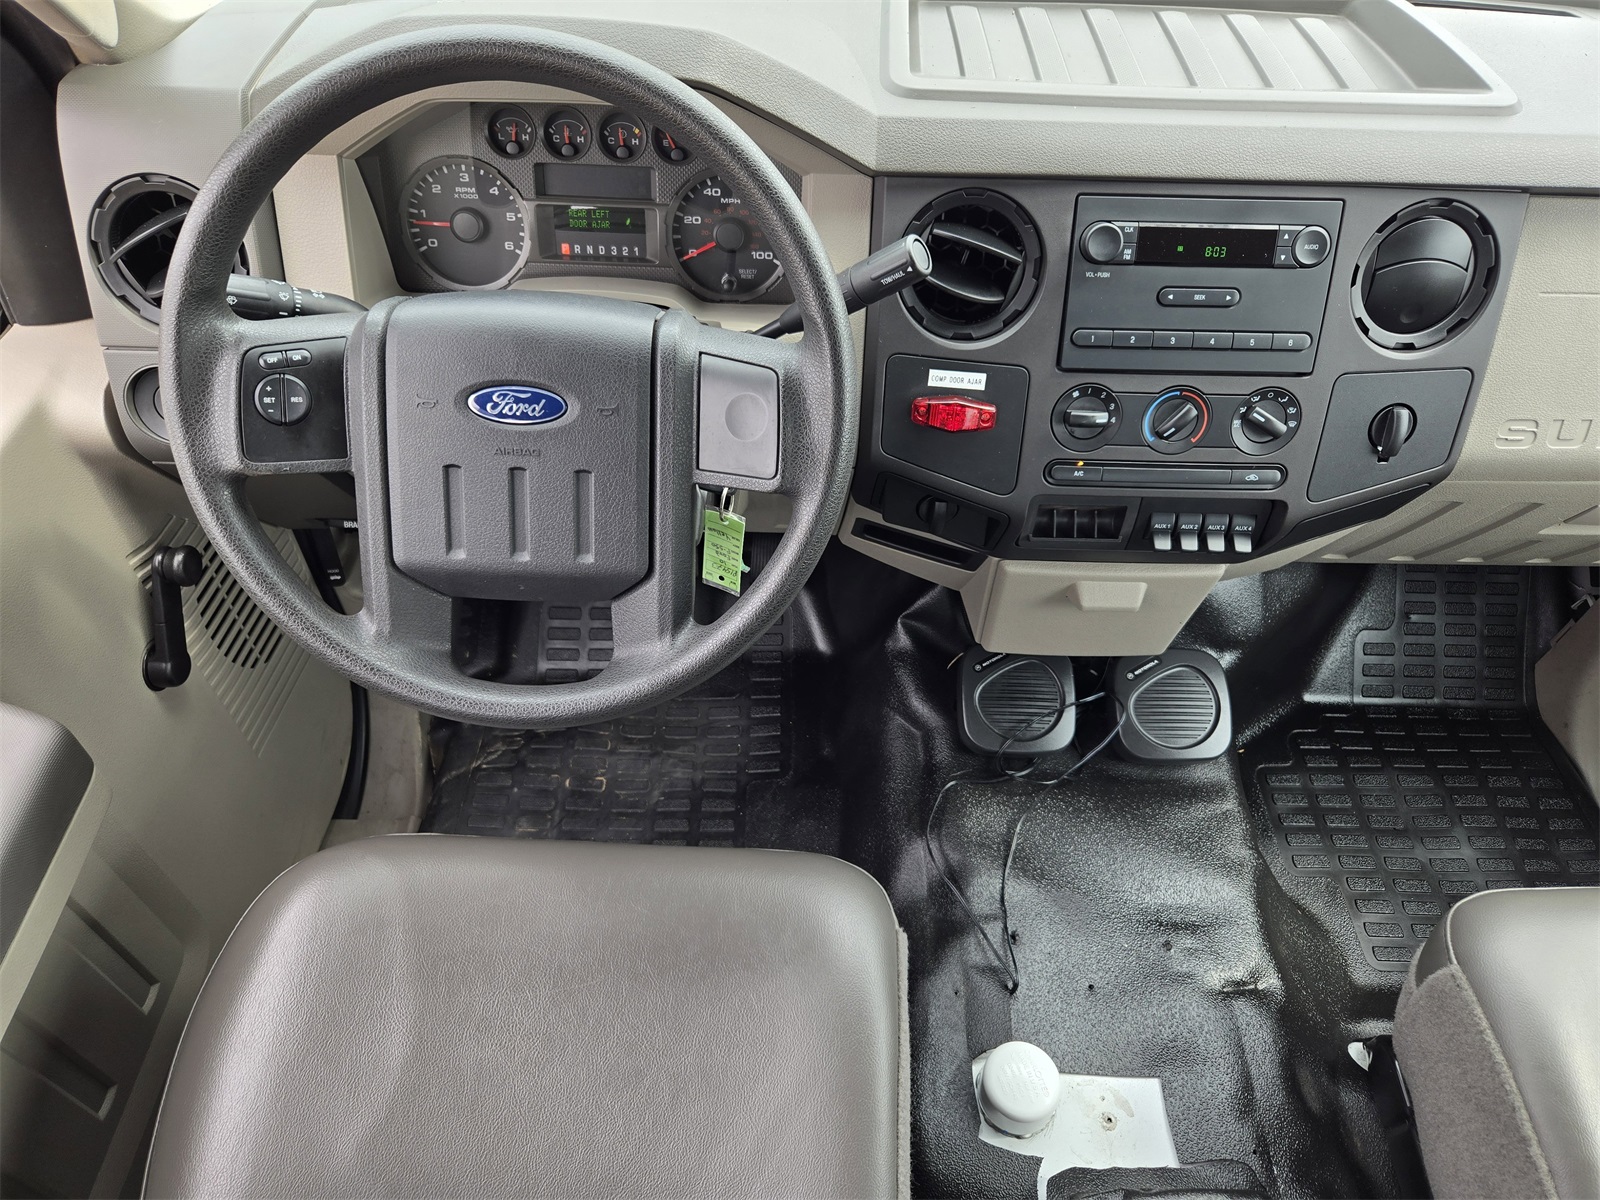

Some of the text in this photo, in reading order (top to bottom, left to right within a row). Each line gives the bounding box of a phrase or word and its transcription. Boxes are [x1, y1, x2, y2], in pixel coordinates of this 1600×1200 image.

[522, 133, 530, 142] H
[552, 134, 560, 143] C
[577, 135, 585, 144] H
[607, 136, 615, 145] C
[631, 138, 639, 146] H
[662, 139, 670, 147] E
[459, 172, 470, 182] 3
[432, 184, 442, 194] 2
[489, 186, 500, 196] 4
[703, 188, 722, 197] 40
[420, 209, 427, 218] 1
[506, 212, 516, 222] 5
[568, 208, 610, 218] REAR LEFT
[569, 220, 611, 229] DOOR AJAR
[684, 216, 702, 225] 20
[428, 238, 438, 248] 0
[504, 241, 514, 250] 6
[574, 244, 581, 254] R
[586, 246, 594, 255] N
[599, 246, 606, 255] D
[611, 246, 618, 256] 3
[622, 246, 629, 256] 2
[634, 247, 639, 256] 1
[1204, 246, 1227, 258] 8:03
[751, 251, 774, 260] 100
[880, 270, 906, 286] TOW/HAUL
[1130, 336, 1136, 344] 2
[1170, 336, 1176, 344] 3
[1209, 337, 1215, 345] 4
[1249, 338, 1255, 346] 5
[1288, 338, 1294, 346] 6
[950, 376, 965, 384] DOOR
[486, 390, 546, 417] Ford
[1494, 418, 1600, 450] SU
[494, 446, 541, 457] AIRBAG
[1134, 660, 1160, 675] MOTOROLA
